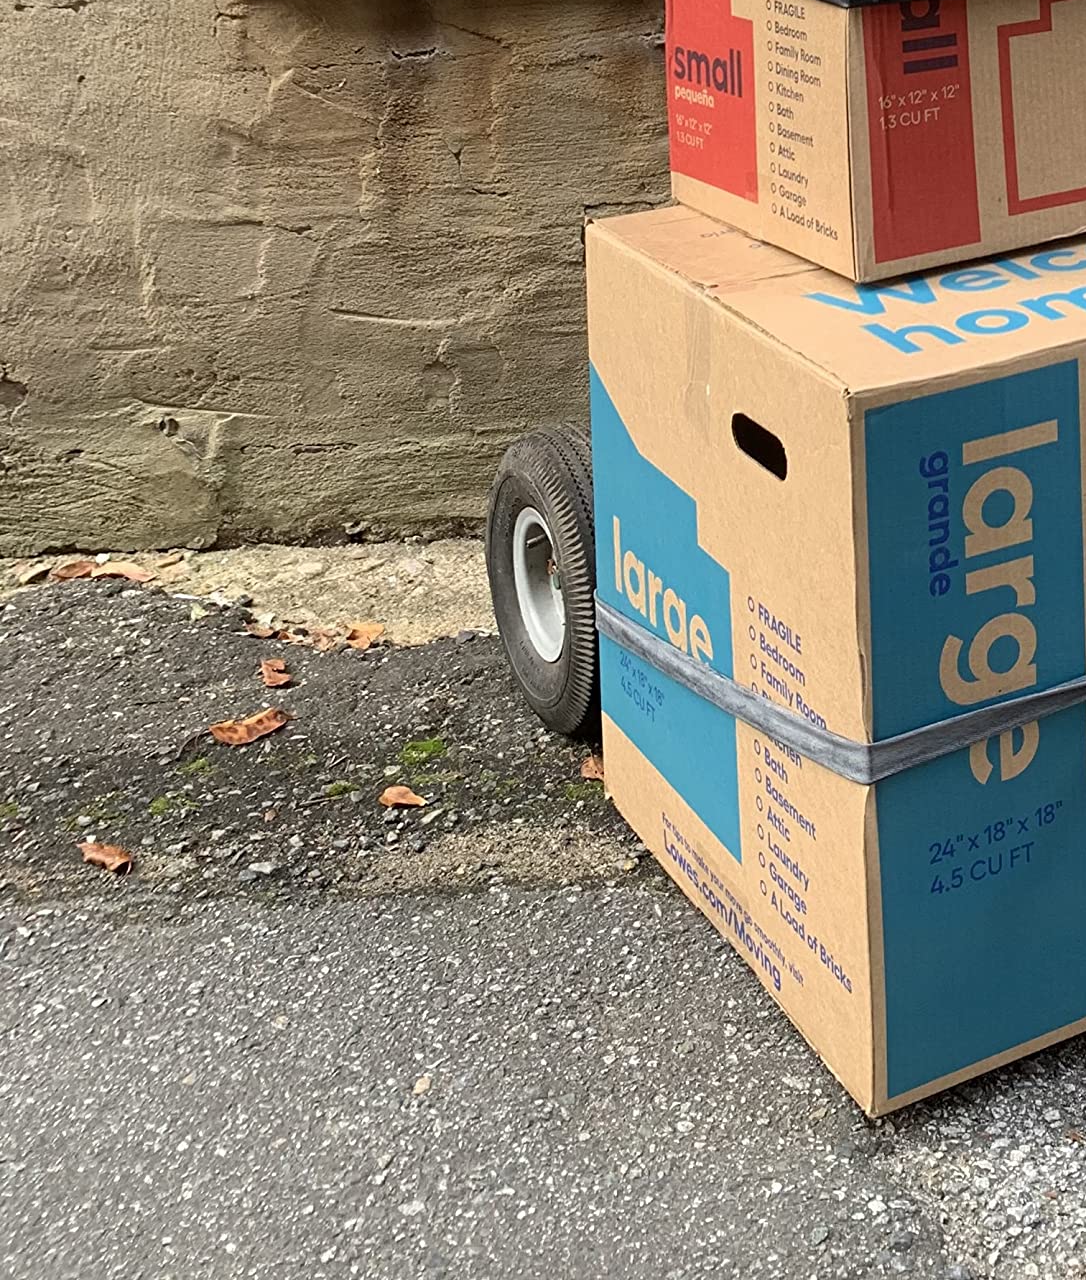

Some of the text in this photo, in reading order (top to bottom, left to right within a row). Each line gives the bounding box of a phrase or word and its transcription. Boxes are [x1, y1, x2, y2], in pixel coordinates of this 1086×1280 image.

[773, 1, 806, 20] FRAGILE
[774, 21, 808, 41] Bedroom
[673, 46, 743, 98] small
[775, 42, 822, 66] Family Room
[775, 62, 821, 87] Dining Room
[776, 82, 804, 103] Kitchen
[674, 85, 715, 108] pequeña
[776, 103, 794, 120] Bath
[878, 84, 960, 109] 16" x 12" x 12"
[777, 123, 814, 148] Basement
[879, 107, 941, 131] 1.3 CU FT
[778, 144, 796, 161] Attic
[778, 164, 809, 188] Laundry
[778, 185, 807, 208] Garage
[779, 207, 838, 241] A Load of Bricks
[919, 450, 960, 597] grande
[939, 418, 1058, 786] large
[758, 602, 802, 655] FRAGILE
[759, 631, 806, 687] Bedroom
[633, 691, 645, 713] CU
[646, 702, 655, 722] FT
[760, 660, 827, 730] Family Room
[764, 746, 789, 784] Bath
[765, 774, 816, 841] Basement
[767, 806, 791, 842] Attic
[928, 801, 1064, 865] 24" x 18" x 18"
[662, 811, 672, 831] For
[672, 823, 684, 845] tips
[684, 835, 691, 854] to
[691, 847, 709, 875] make
[710, 870, 724, 891] your
[725, 887, 743, 914] move
[743, 909, 753, 927] go
[767, 832, 810, 892] Laundry
[930, 842, 1034, 896] 4.5 CU FT
[769, 862, 807, 915] Garage
[663, 829, 781, 992] Lowes.com/Moving
[770, 890, 852, 994] A Load of Bricks
